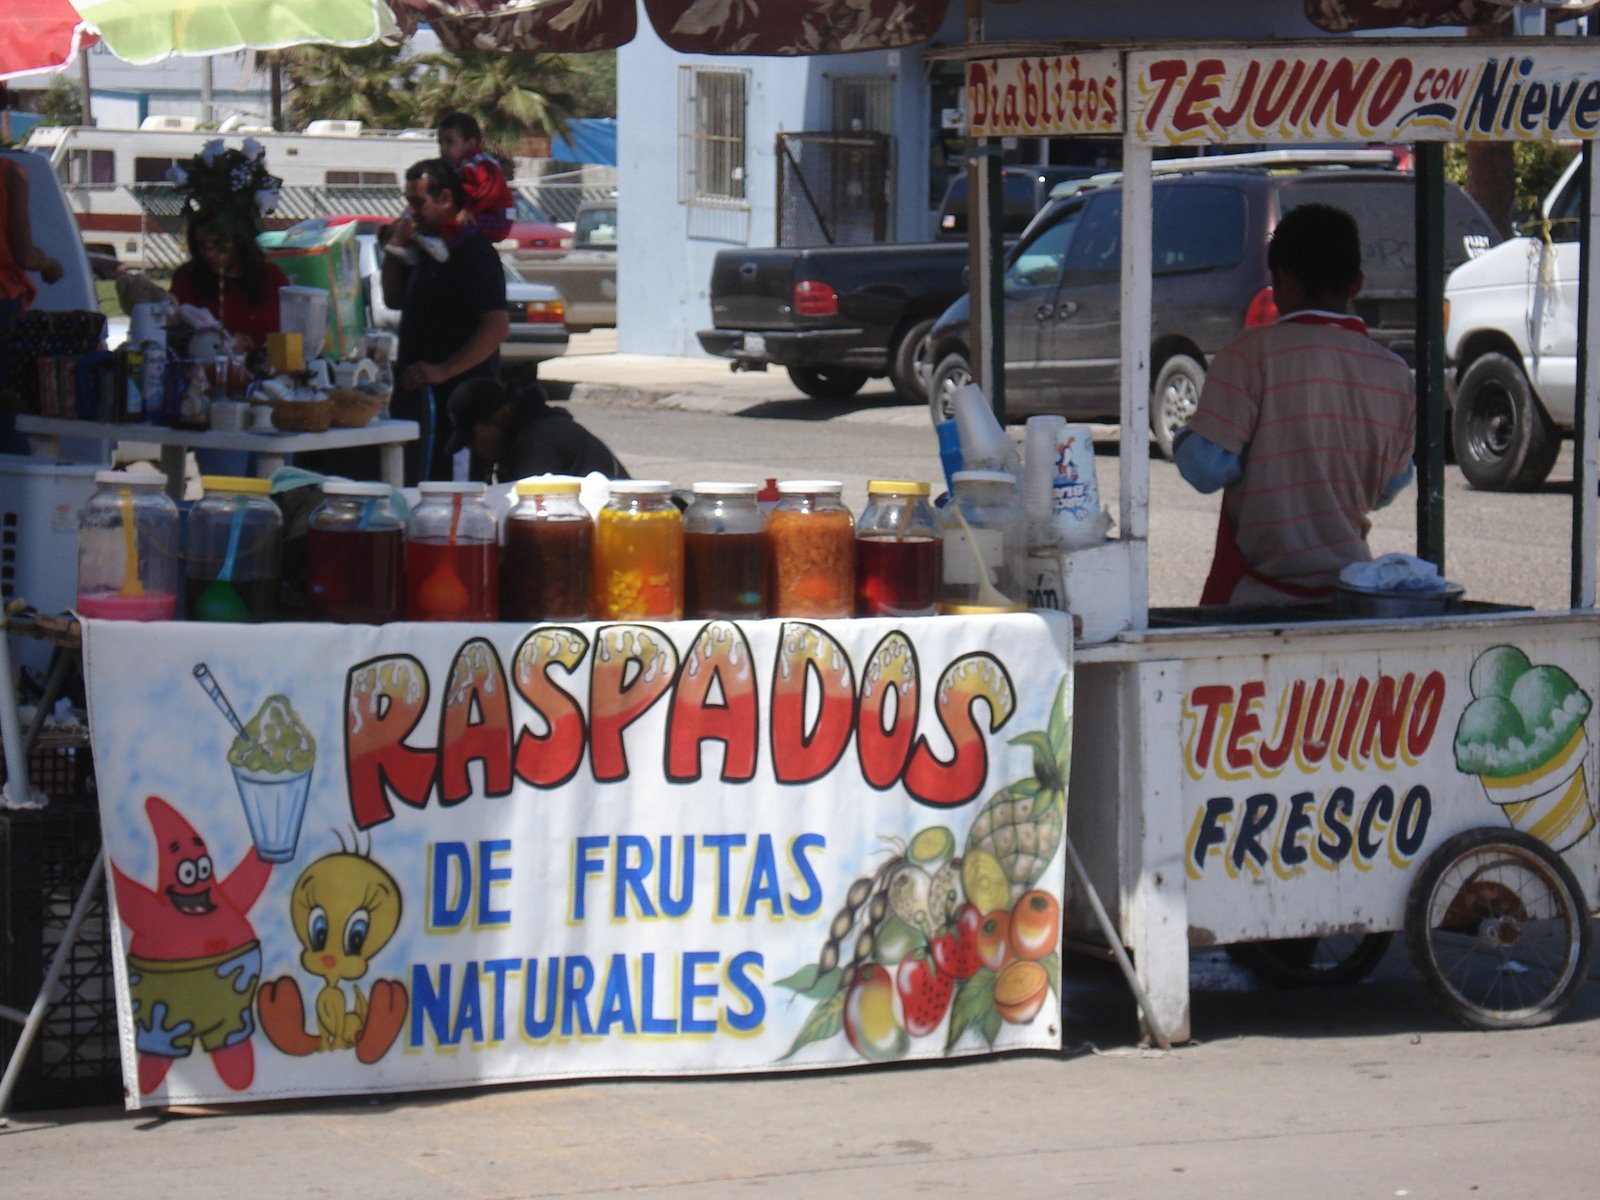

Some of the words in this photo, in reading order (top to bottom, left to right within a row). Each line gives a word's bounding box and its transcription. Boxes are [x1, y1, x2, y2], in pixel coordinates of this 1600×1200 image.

[967, 56, 1118, 130] Diablitos
[1143, 57, 1412, 136] TEJUINO
[1414, 68, 1470, 103] CON
[1462, 57, 1600, 135] Nieve
[344, 620, 1016, 829] RASPADOS
[1188, 670, 1445, 774] TEJUINO
[1190, 785, 1432, 875] FRESCO
[430, 838, 513, 930] DE
[571, 832, 827, 924] FRUTAS
[407, 950, 767, 1050] NATURALES
